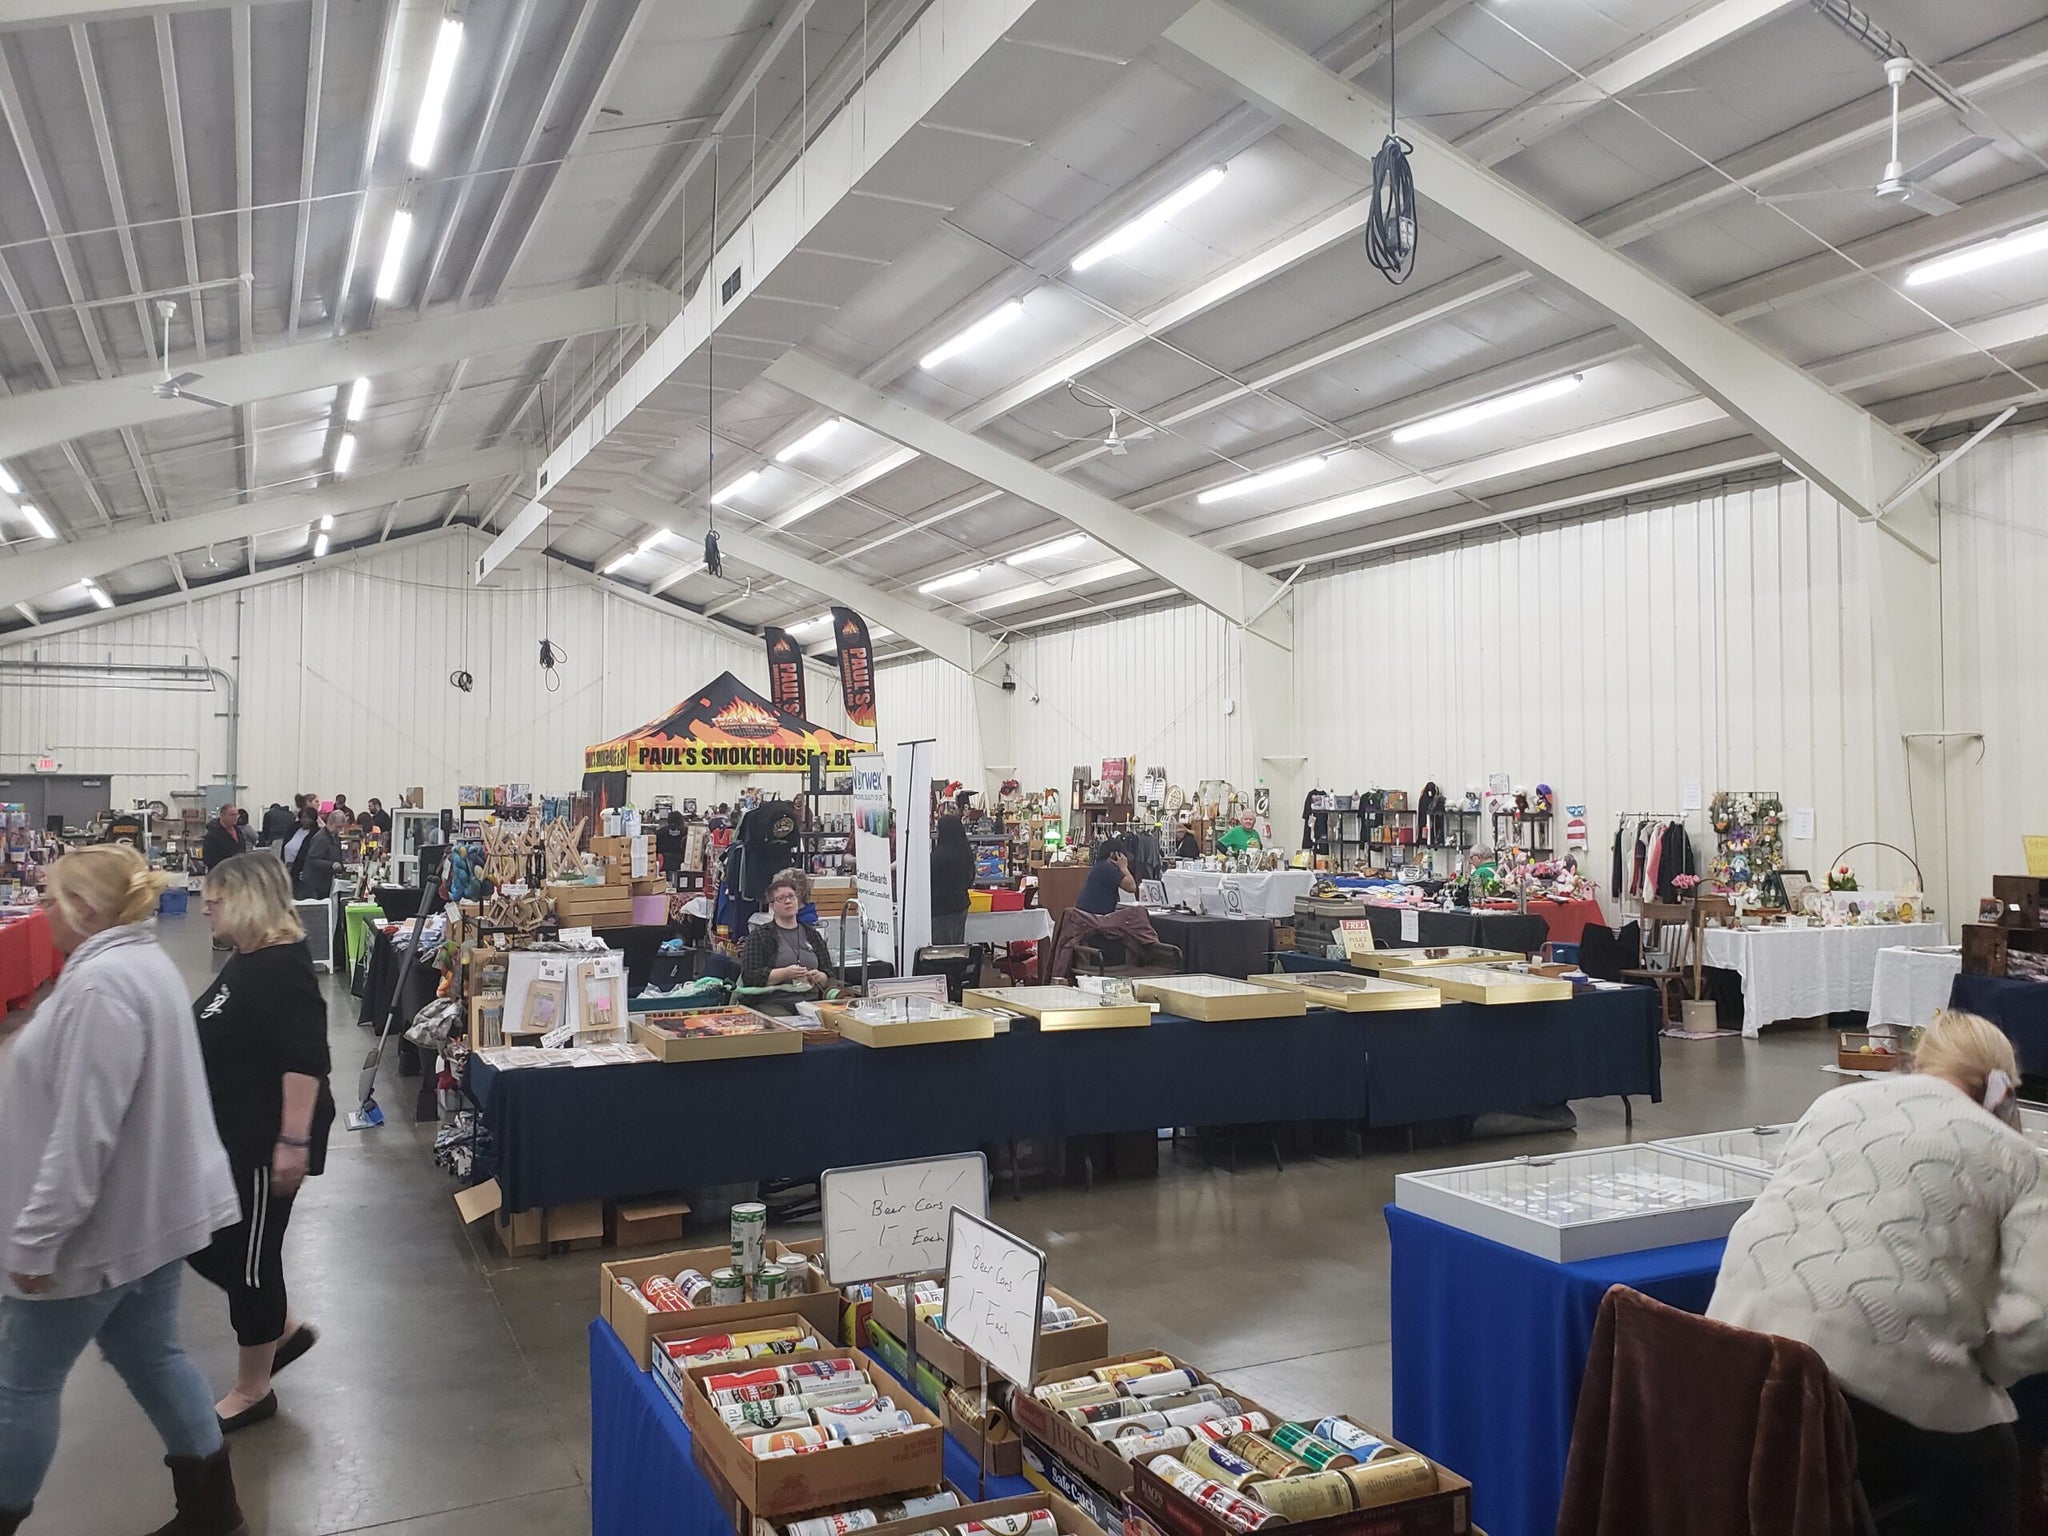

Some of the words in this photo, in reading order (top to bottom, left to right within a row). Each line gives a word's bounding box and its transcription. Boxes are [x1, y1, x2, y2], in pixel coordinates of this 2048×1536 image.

[780, 662, 800, 716] PAUL'S
[849, 647, 871, 705] PAUL'S
[40, 759, 54, 769] EXIT
[639, 747, 697, 766] PAUL'S
[853, 766, 882, 791] Norwex
[1345, 921, 1366, 930] FREE
[871, 1199, 905, 1217] Beer
[911, 1226, 944, 1246] Each
[971, 1245, 994, 1275] Beer
[985, 1299, 1010, 1336] Each
[1051, 1417, 1101, 1472] JUICES
[1051, 1467, 1071, 1494] Safe
[1071, 1484, 1100, 1523] Catch
